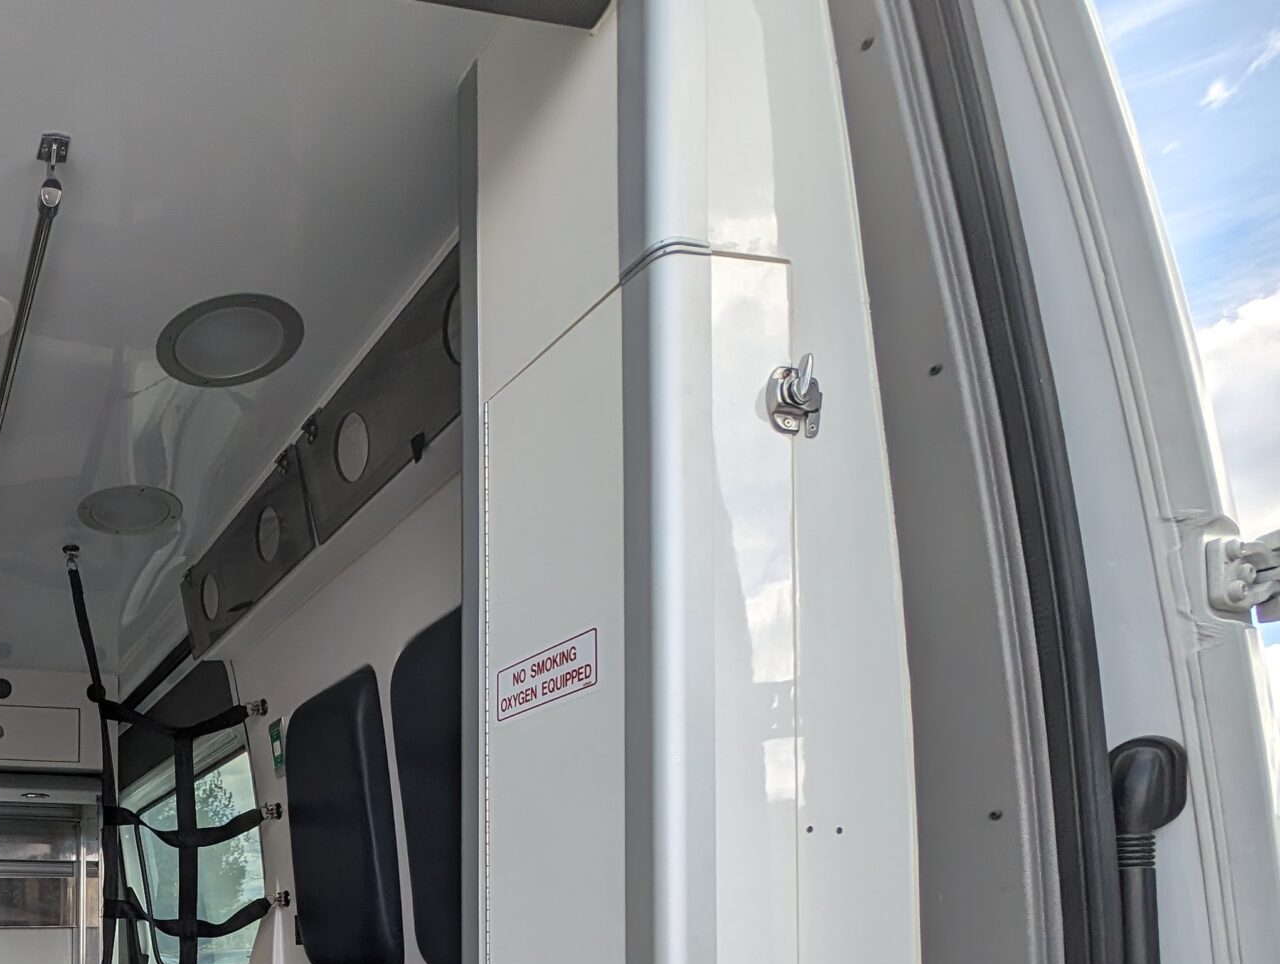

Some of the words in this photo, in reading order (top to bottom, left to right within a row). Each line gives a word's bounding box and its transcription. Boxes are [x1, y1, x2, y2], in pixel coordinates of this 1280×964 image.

[500, 686, 538, 713] OXYGEN
[541, 664, 592, 697] EQUIPPED
[512, 669, 526, 687] NO
[530, 646, 577, 679] SMOKING
